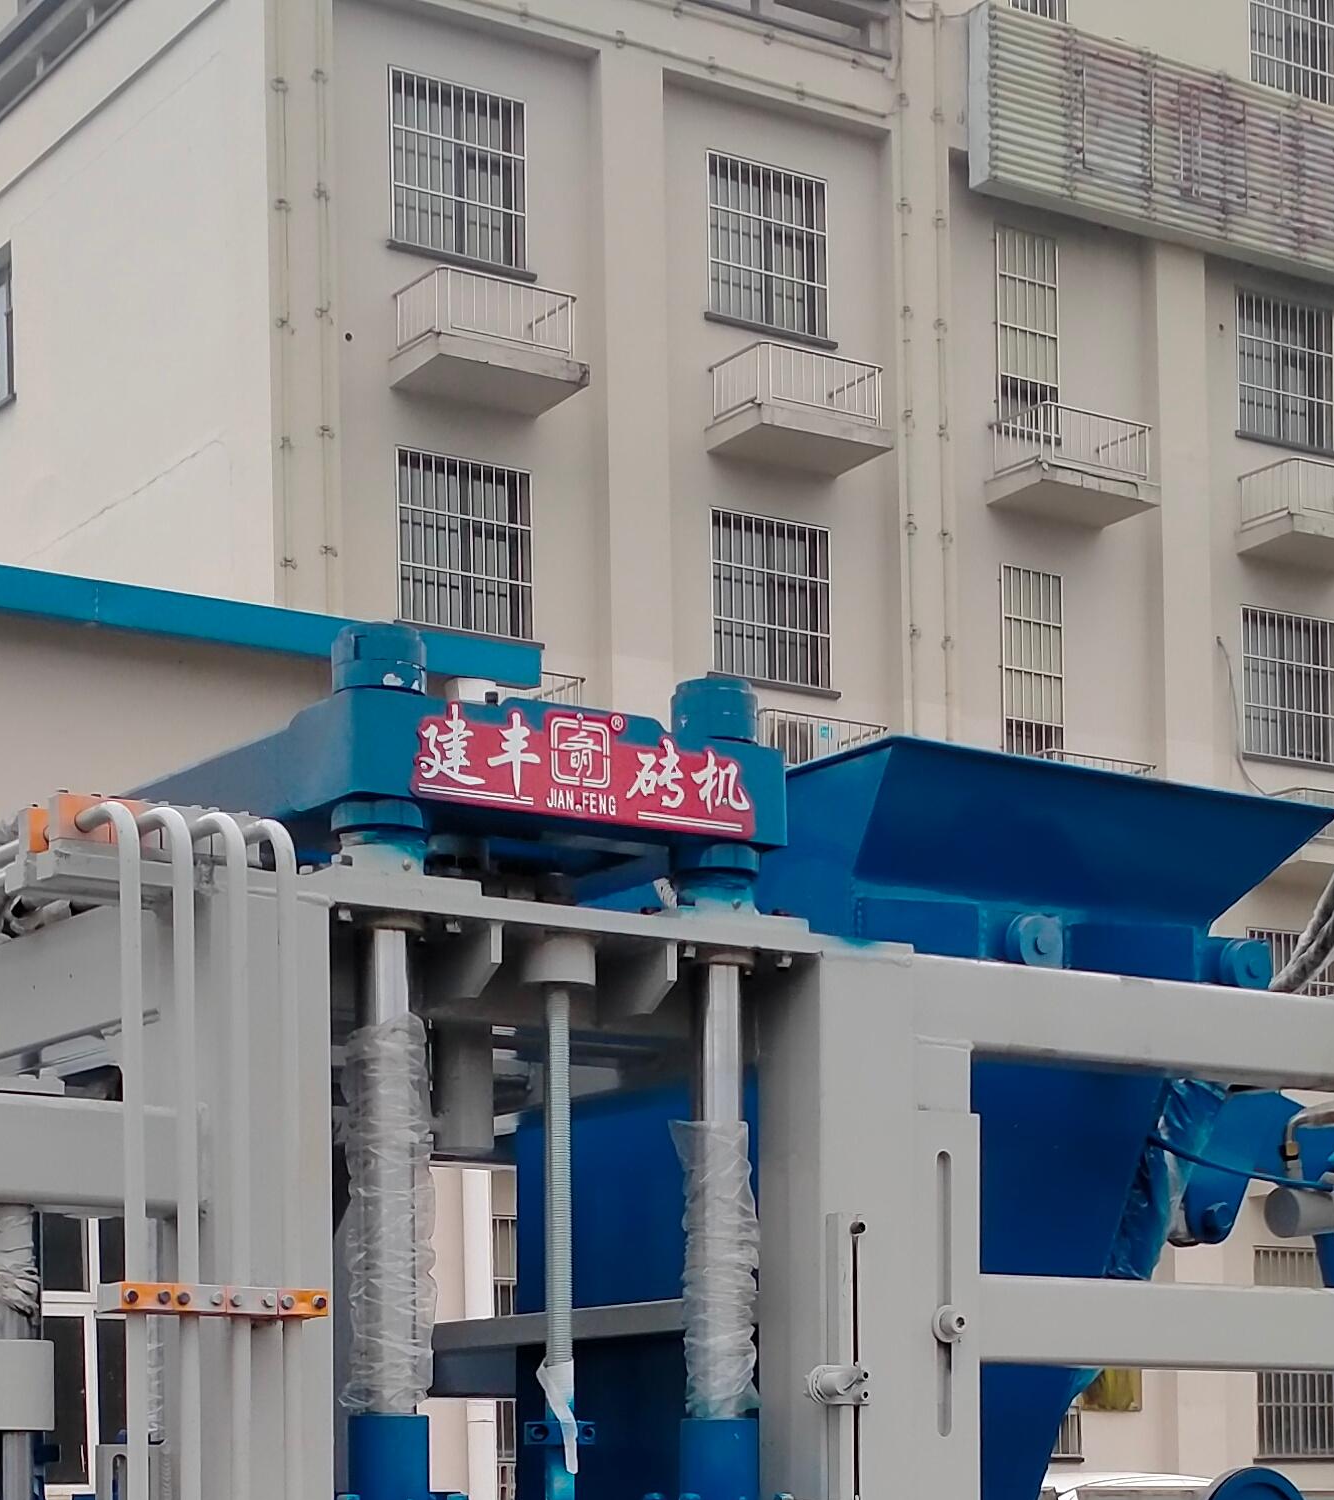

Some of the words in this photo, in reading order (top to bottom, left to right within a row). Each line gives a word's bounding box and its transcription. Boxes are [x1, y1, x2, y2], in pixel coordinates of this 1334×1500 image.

[420, 704, 540, 797] 建丰
[626, 738, 750, 812] 砖机
[582, 792, 617, 815] FENG
